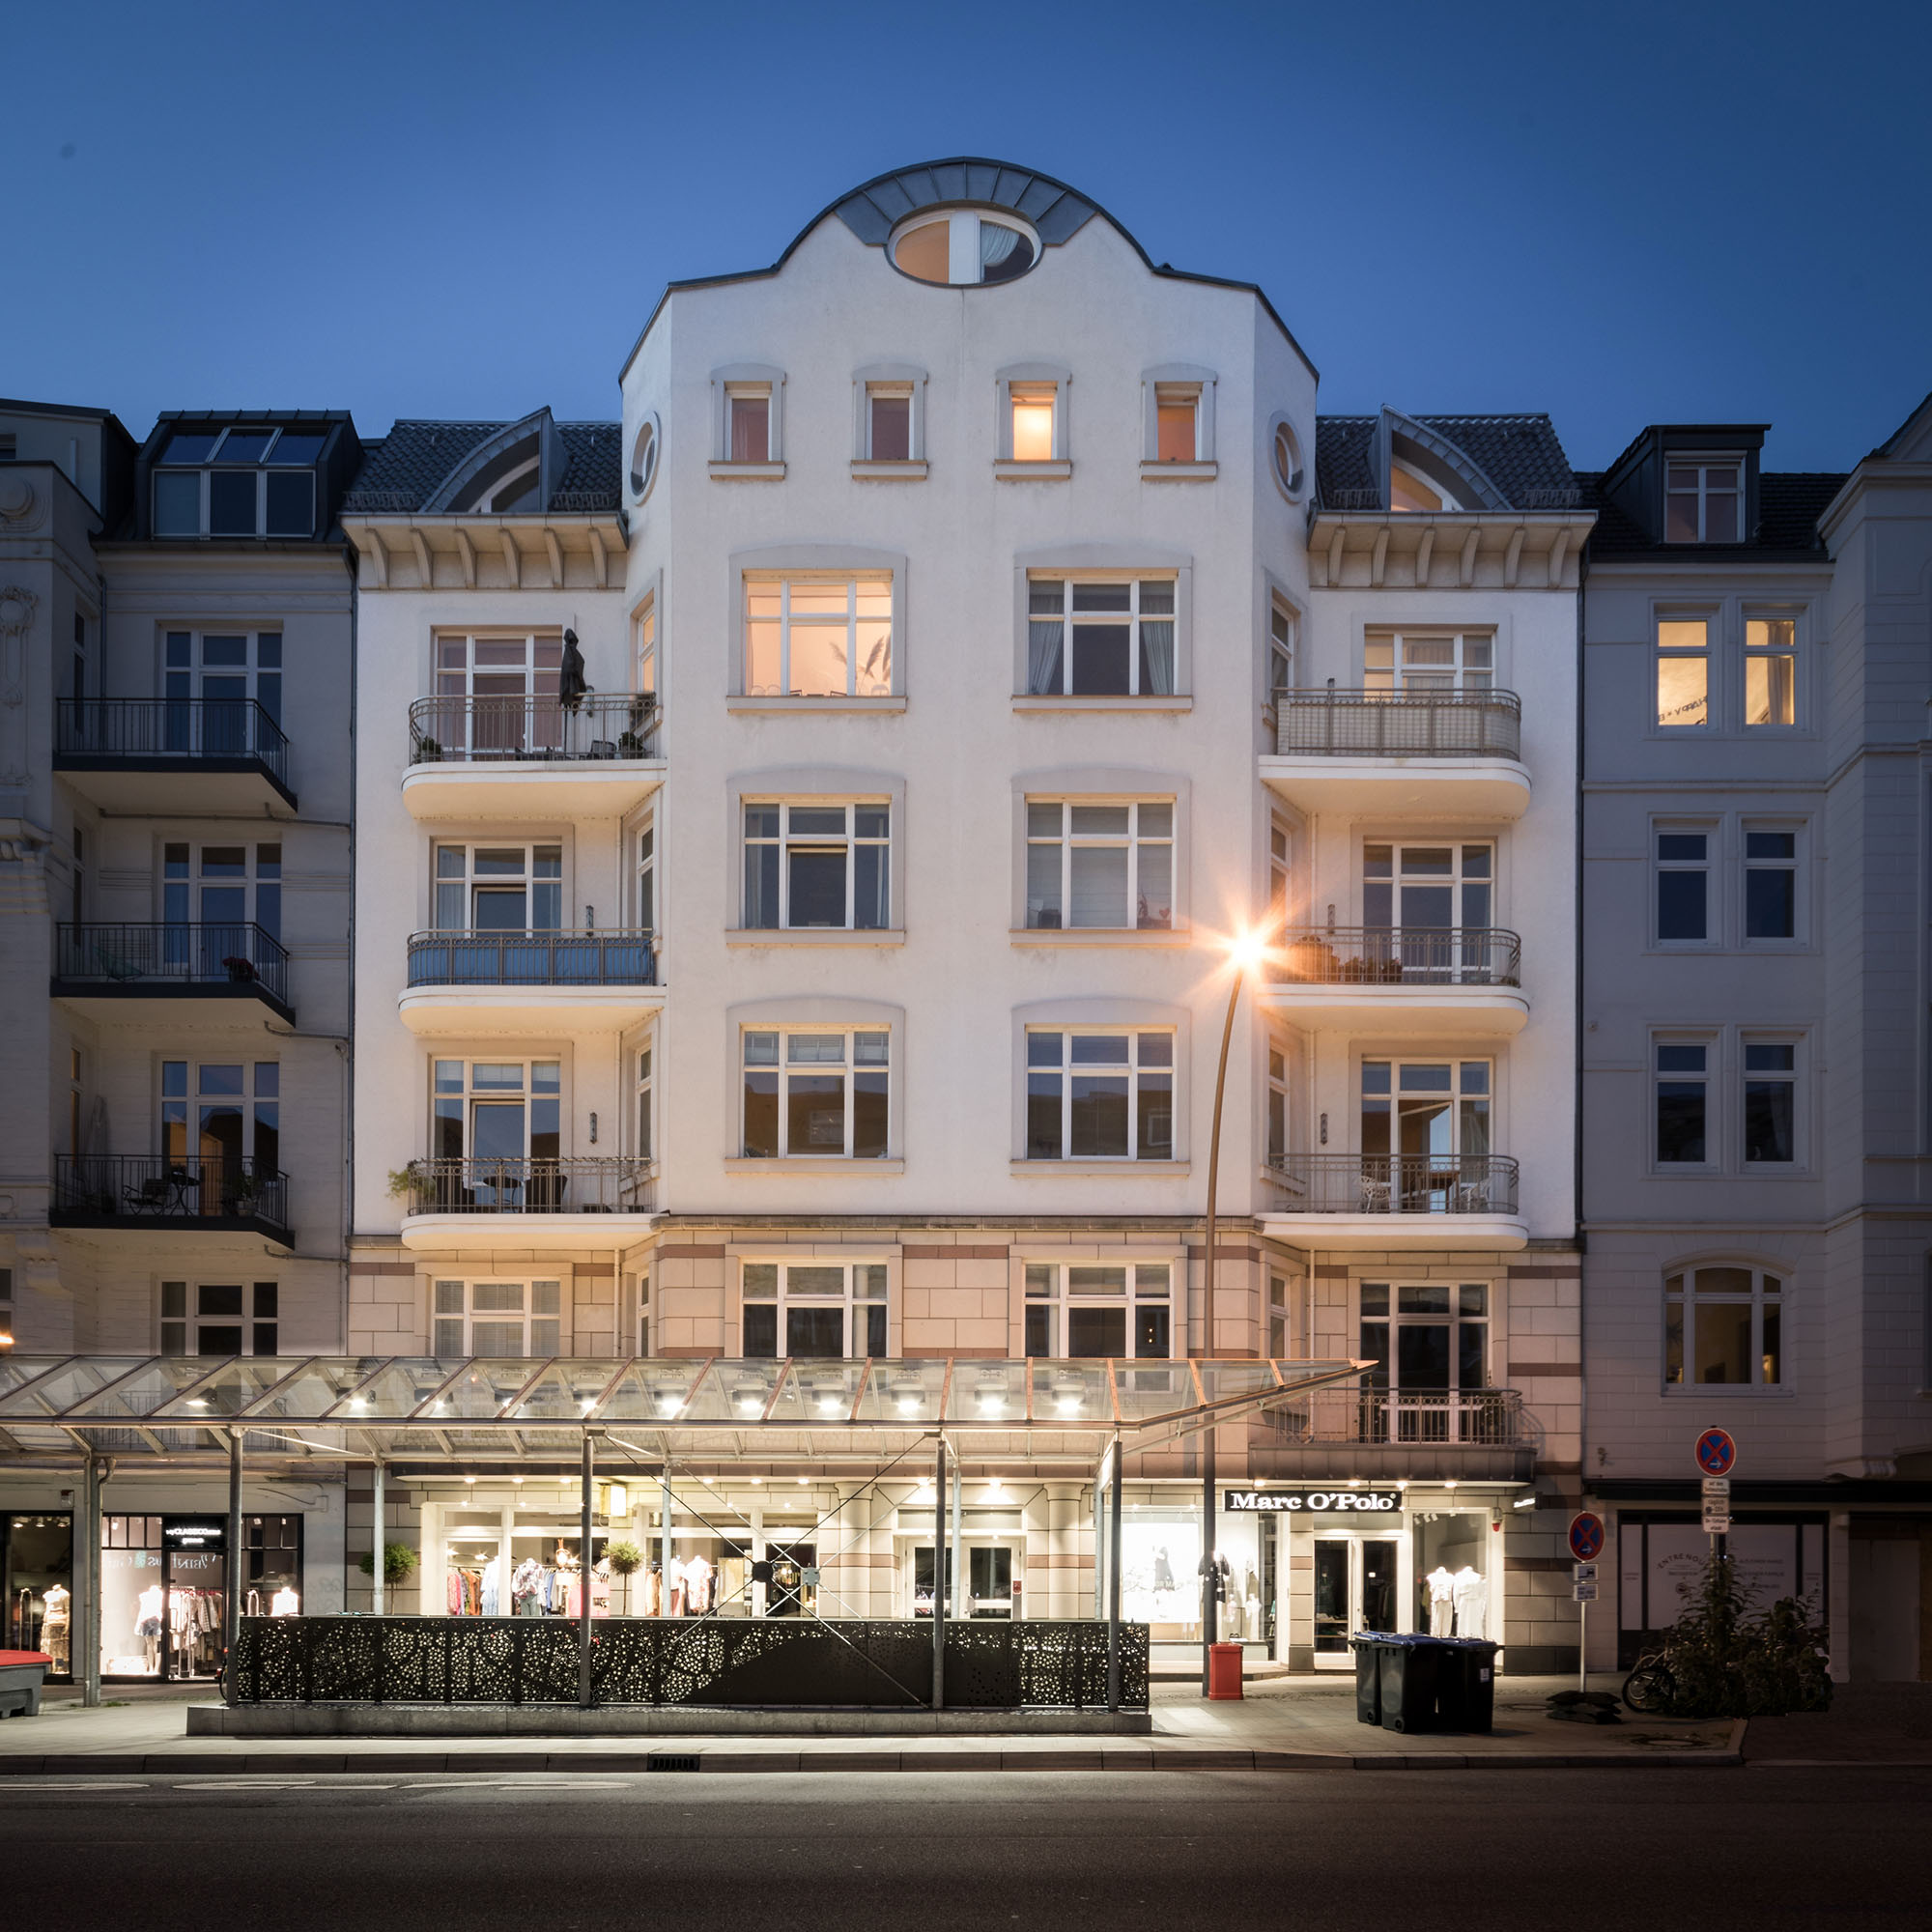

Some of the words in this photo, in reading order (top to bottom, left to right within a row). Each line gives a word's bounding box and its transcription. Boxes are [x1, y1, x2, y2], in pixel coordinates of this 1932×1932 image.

[1230, 1492, 1302, 1510] Marc
[1307, 1492, 1394, 1510] O'Polo
[1658, 1552, 1685, 1569] ENTRE
[1686, 1553, 1708, 1567] NOU
